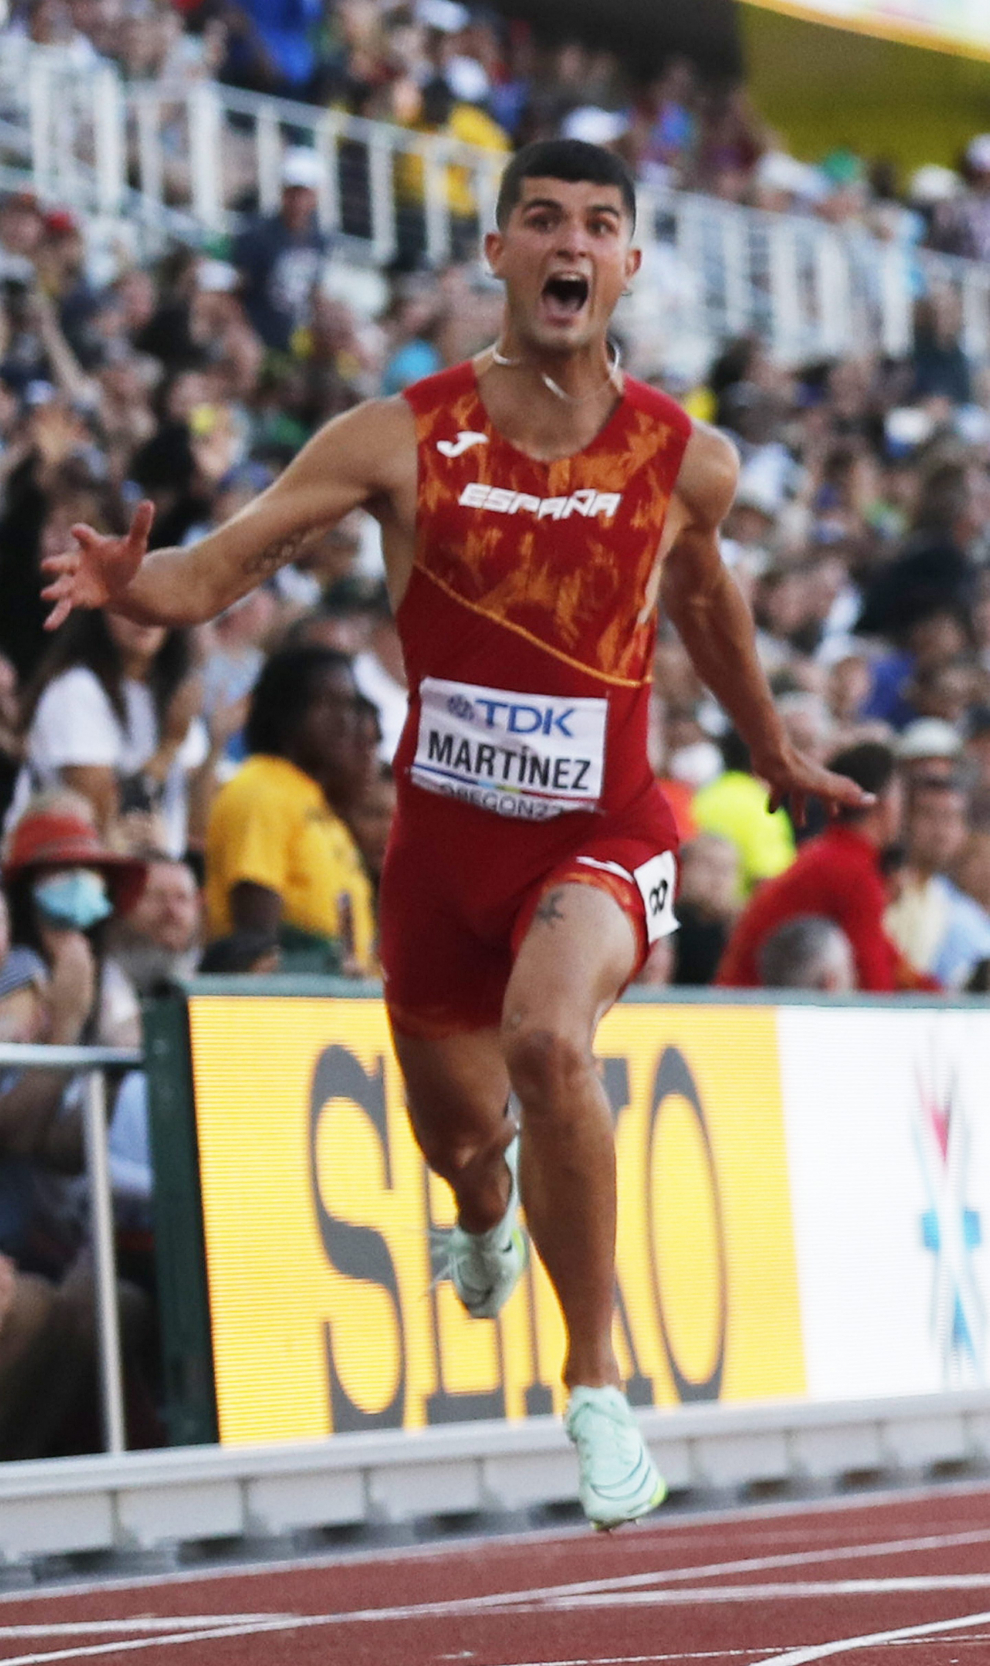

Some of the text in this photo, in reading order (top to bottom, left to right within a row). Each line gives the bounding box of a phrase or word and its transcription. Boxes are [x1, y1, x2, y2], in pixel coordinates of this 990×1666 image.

[458, 482, 622, 520] ESPAÑA
[476, 699, 575, 737] TDK
[427, 730, 592, 790] MARTÍNEZ
[309, 1043, 728, 1433] SEIO
